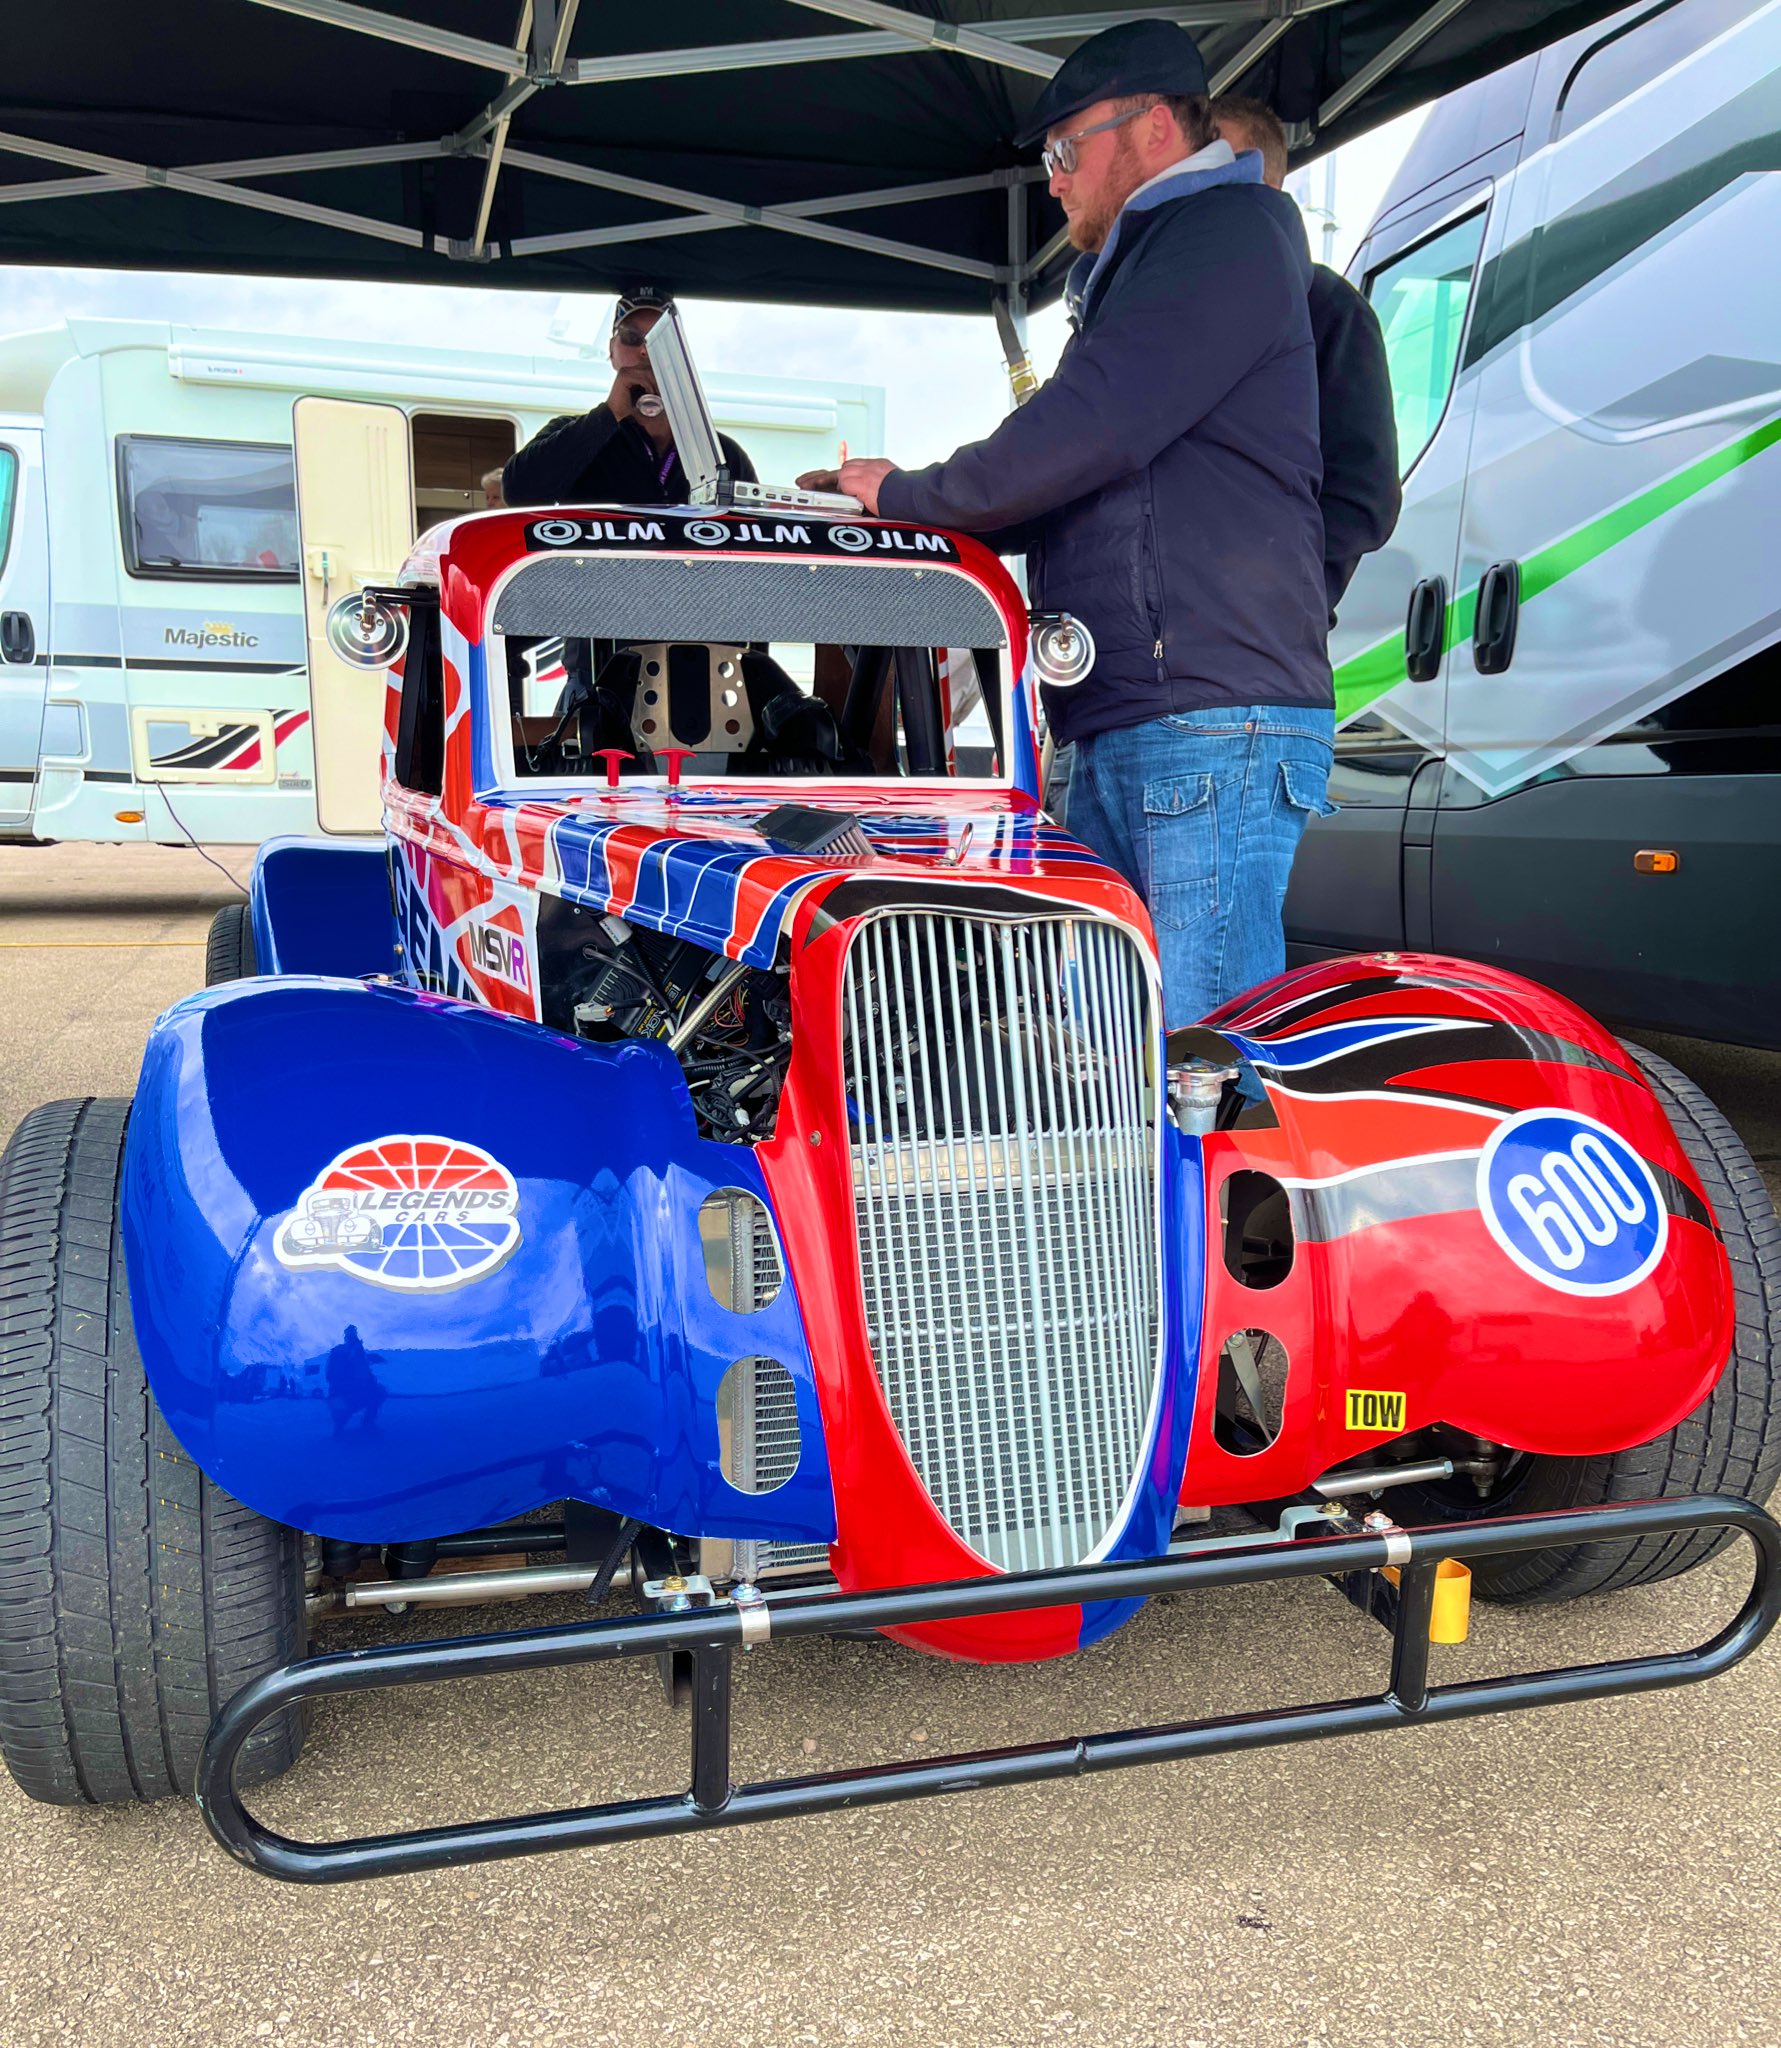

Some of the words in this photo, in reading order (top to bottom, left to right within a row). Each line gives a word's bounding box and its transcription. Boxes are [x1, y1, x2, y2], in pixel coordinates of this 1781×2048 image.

[584, 521, 666, 541] JLM
[733, 523, 812, 545] JLM
[876, 529, 951, 553] JLM
[164, 627, 260, 649] Majestic
[468, 920, 527, 994] MSVR
[359, 1190, 510, 1210] LEGENDS
[395, 1210, 470, 1222] CARS
[1506, 1132, 1647, 1271] 600
[1349, 1393, 1403, 1428] TOW
